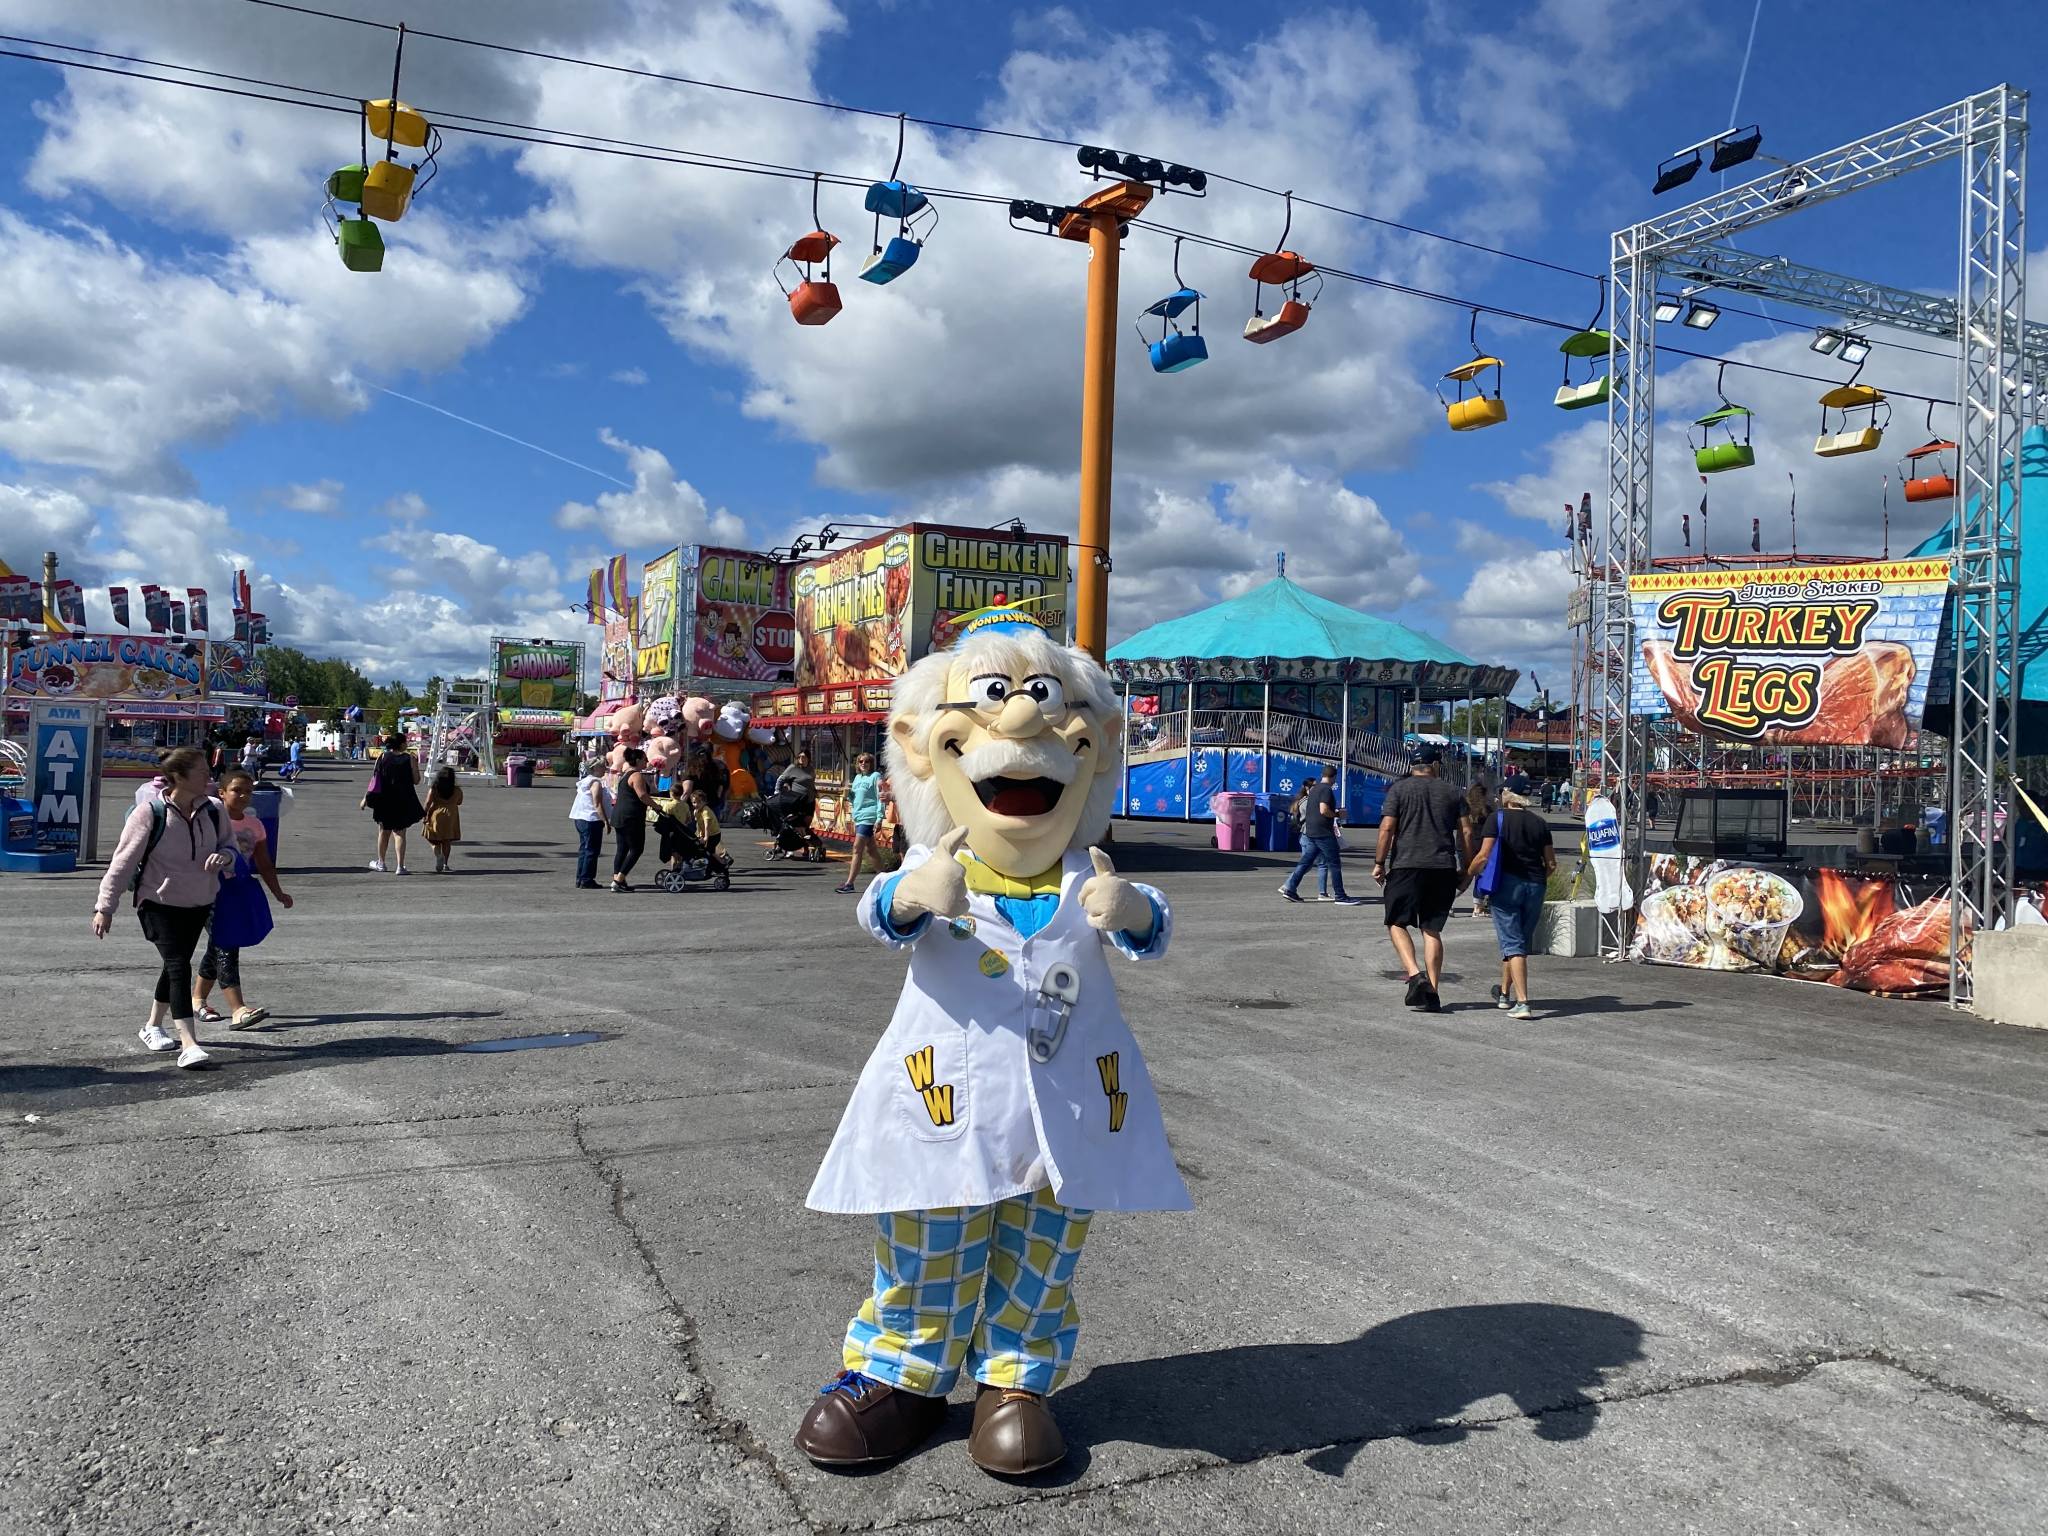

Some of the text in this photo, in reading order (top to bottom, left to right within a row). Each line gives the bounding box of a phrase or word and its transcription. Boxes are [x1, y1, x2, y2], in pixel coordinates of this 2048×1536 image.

[885, 551, 909, 567] WINGS
[925, 532, 1058, 577] CHICKEN
[702, 556, 775, 607] GAME
[815, 579, 852, 631] FRENCH
[853, 565, 885, 622] FRIES
[938, 570, 1043, 617] FINGER
[1741, 580, 1882, 599] JUMBO SMOKED
[1664, 596, 1872, 652] TURKEY
[12, 640, 200, 684] FUNNEL CAKES
[503, 653, 572, 680] LEMONADE
[637, 642, 670, 678] WIN
[48, 707, 81, 720] ATM
[1699, 660, 1813, 728] LEGS
[515, 713, 565, 724] LEMONADE
[37, 730, 80, 824] ATM
[1588, 825, 1618, 841] AQUAFINA
[905, 1045, 934, 1092] W
[923, 1084, 954, 1126] W
